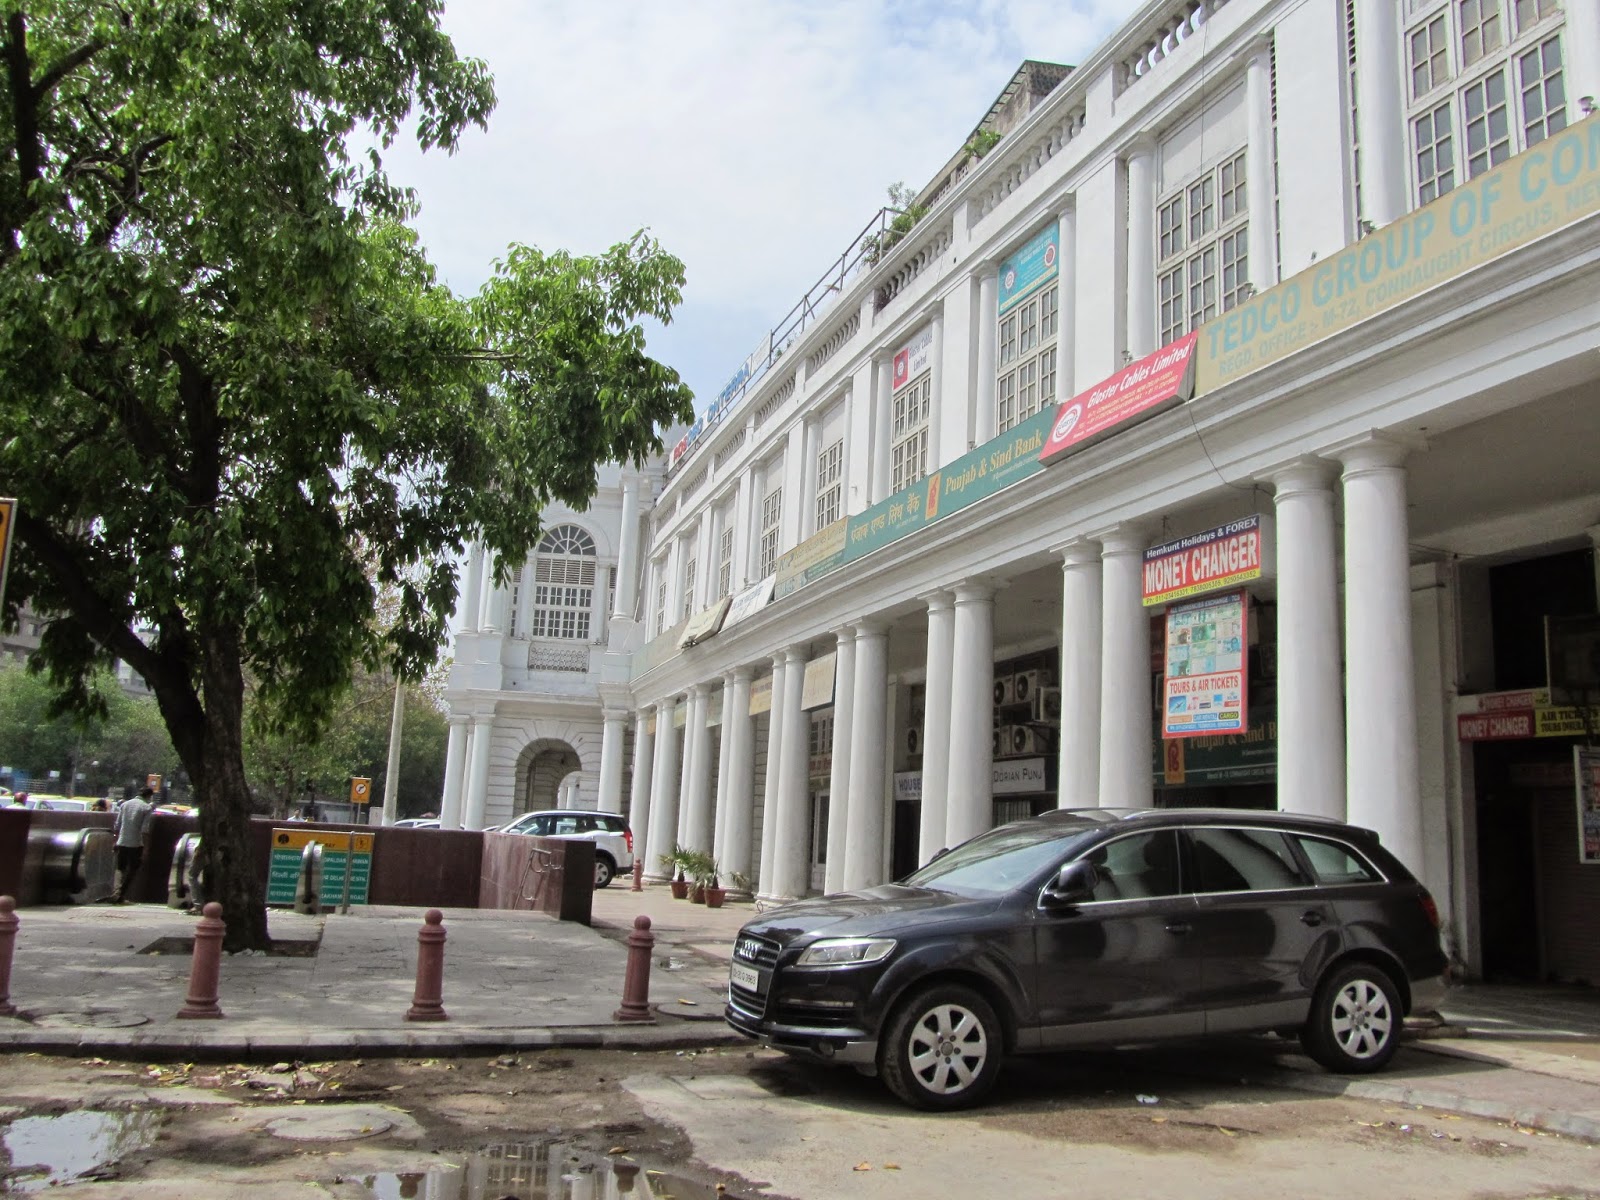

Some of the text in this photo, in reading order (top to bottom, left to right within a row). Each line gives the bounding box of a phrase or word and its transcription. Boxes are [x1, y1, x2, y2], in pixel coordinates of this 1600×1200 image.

[1206, 279, 1301, 360] TEDCO
[1312, 210, 1435, 307] GROUP
[1449, 176, 1503, 237] OF
[1366, 241, 1473, 308] CONNAUGHT
[1087, 383, 1120, 409] Gloster
[1120, 366, 1150, 391] Cables
[1151, 341, 1191, 375] Limited
[945, 465, 976, 495] Punjab
[979, 458, 988, 476] &
[990, 447, 1012, 472] Sind
[1015, 429, 1043, 455] Bank
[1145, 532, 1258, 594] MONEY CHANGER
[1147, 517, 1257, 559] Hemkunt Holidays & FOREX
[1169, 676, 1239, 695] TOURS & AIR TICKETS
[1541, 711, 1557, 721] AIR
[1460, 716, 1529, 738] MONEY CHANGER
